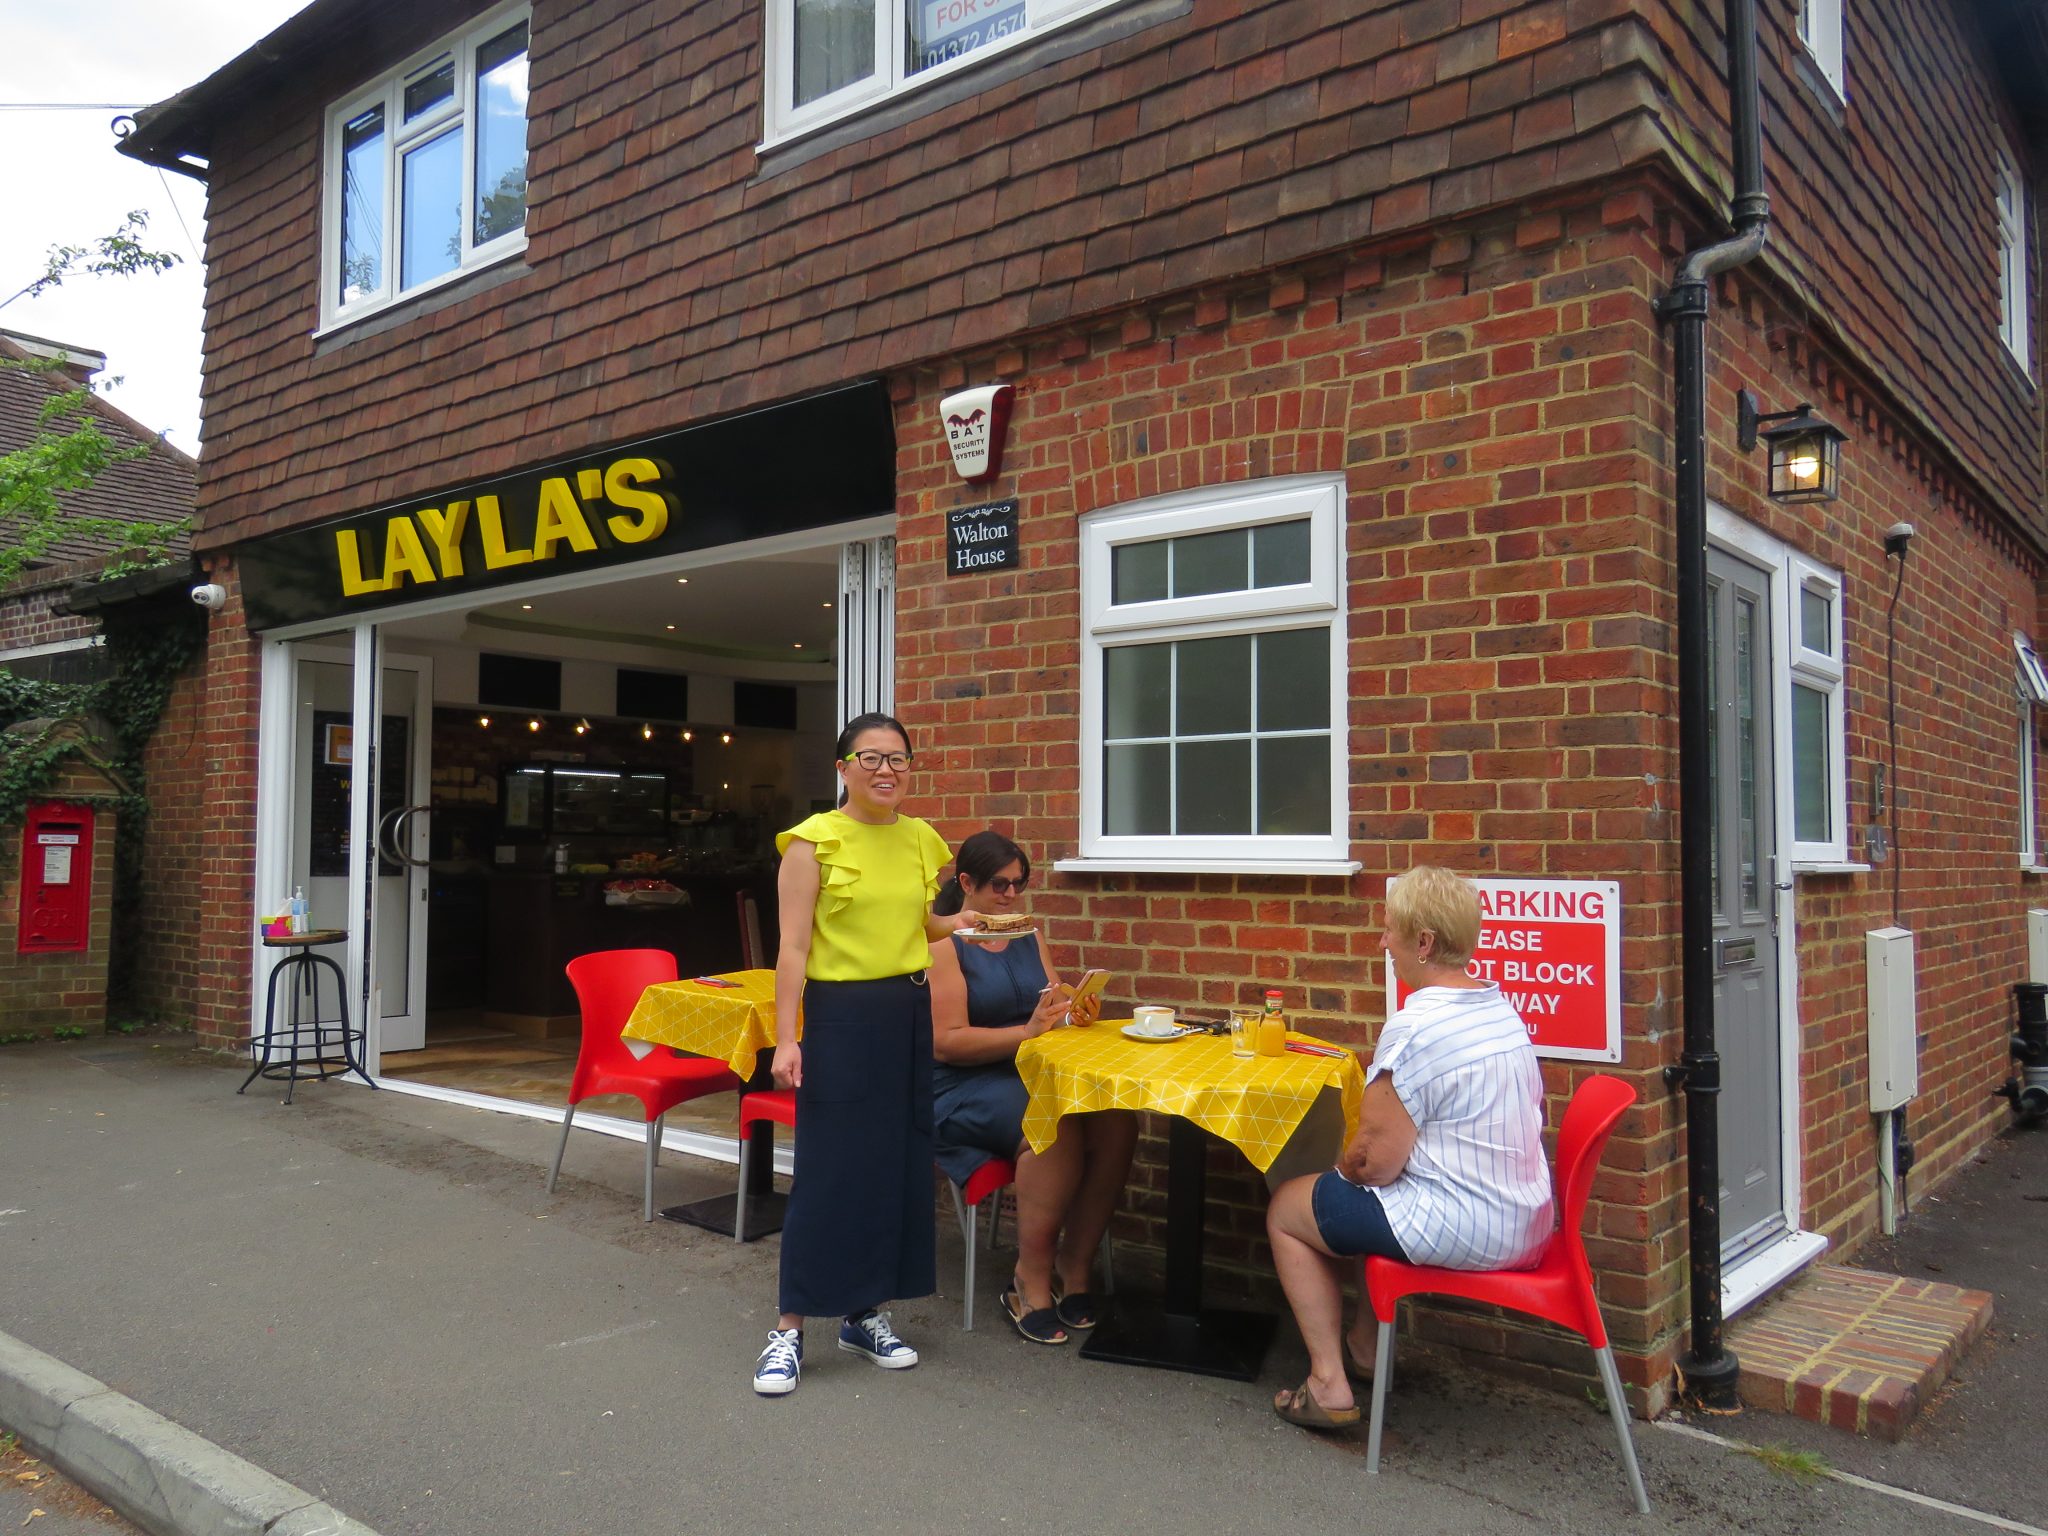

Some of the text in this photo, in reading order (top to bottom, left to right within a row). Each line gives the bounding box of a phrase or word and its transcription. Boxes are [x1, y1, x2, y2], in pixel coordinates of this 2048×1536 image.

[936, 0, 977, 29] FOR
[927, 31, 980, 68] 01372
[951, 424, 985, 439] BAT
[953, 438, 985, 450] SECURITY
[955, 449, 985, 460] SYSTEMS
[336, 458, 669, 597] LAYLA'S
[953, 522, 1008, 545] Walton
[956, 549, 1006, 569] House
[1478, 889, 1604, 919] ARKING
[1477, 929, 1543, 952] EASE
[1464, 958, 1595, 986] OT BLOCK
